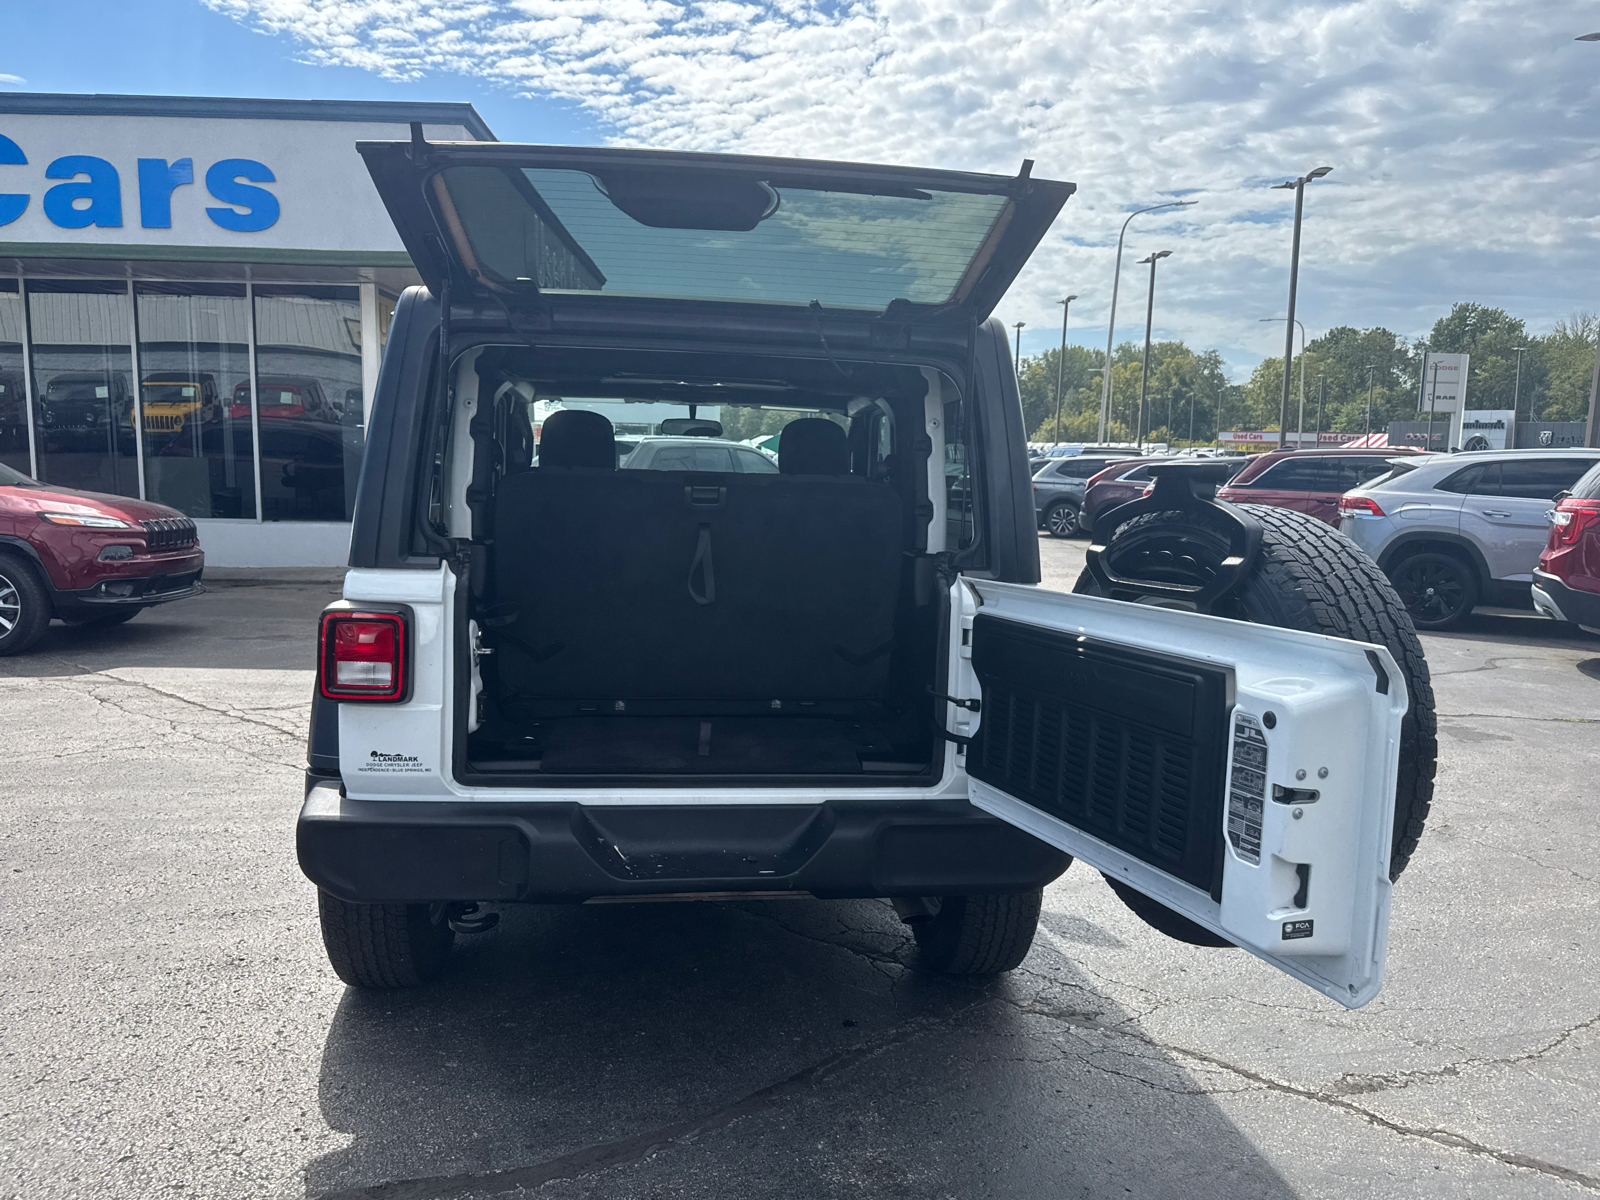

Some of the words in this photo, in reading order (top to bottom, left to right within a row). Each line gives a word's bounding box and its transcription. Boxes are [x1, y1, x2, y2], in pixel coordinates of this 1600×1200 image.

[1463, 420, 1505, 430] ndmark
[1233, 432, 1248, 440] Used
[1249, 432, 1263, 440] Cars
[1340, 434, 1360, 442] Cars
[1240, 716, 1253, 725] Jeep
[1235, 726, 1264, 740] JL
[1245, 827, 1260, 838] USA
